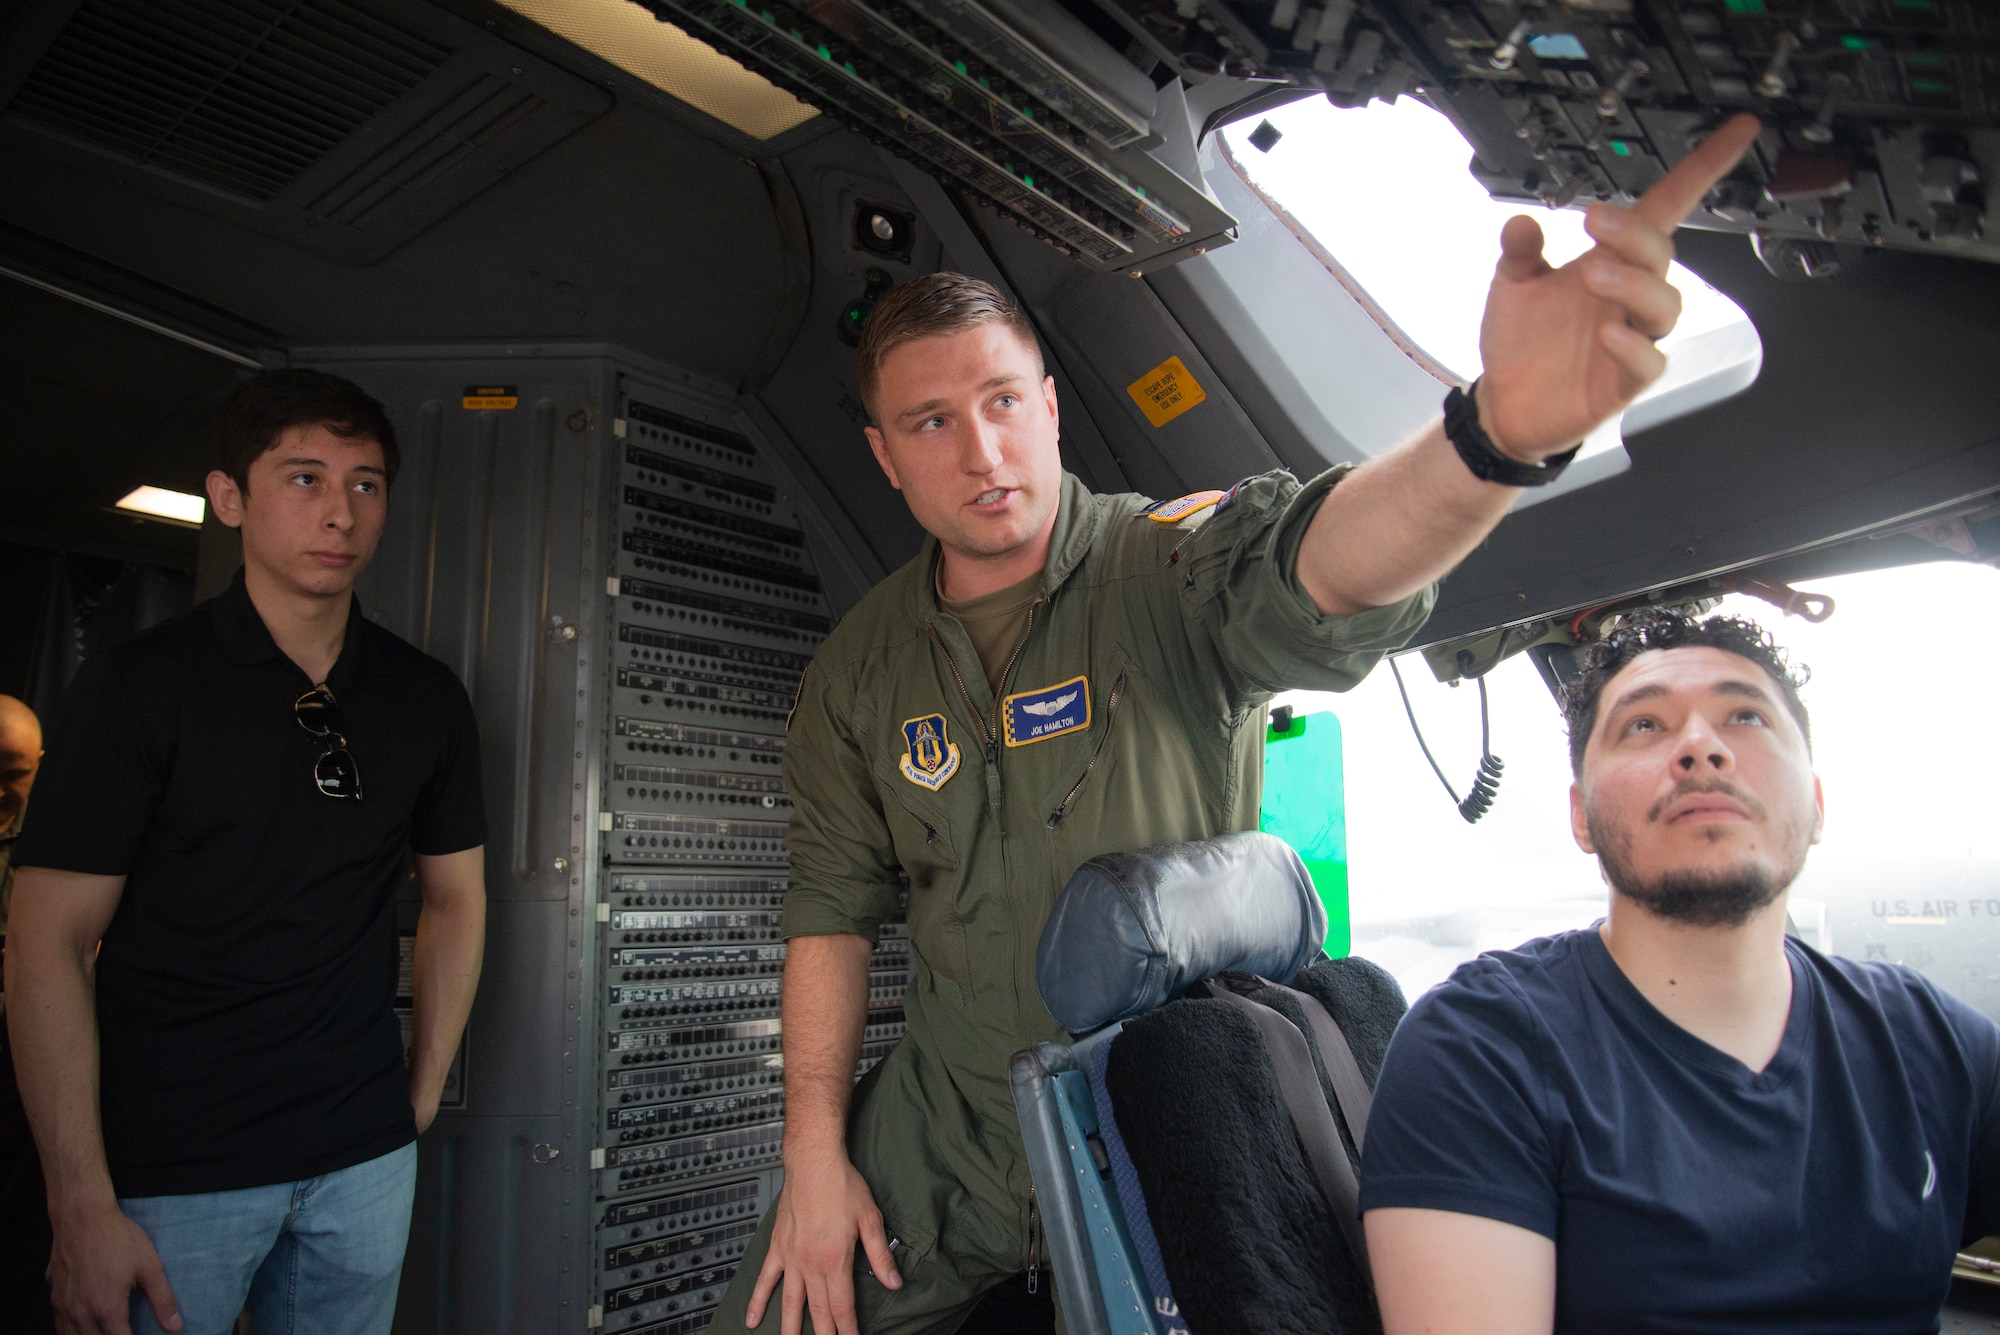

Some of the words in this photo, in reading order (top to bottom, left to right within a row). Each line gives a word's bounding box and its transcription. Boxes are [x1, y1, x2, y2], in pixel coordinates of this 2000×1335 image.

[477, 387, 505, 395] CAUTION
[1151, 382, 1179, 404] EMERGENCY
[1030, 725, 1043, 736] JOE
[1044, 716, 1075, 733] HAMILTON
[905, 765, 914, 776] AIR
[1872, 899, 1917, 918] U.S.
[1922, 899, 1959, 918] AIR
